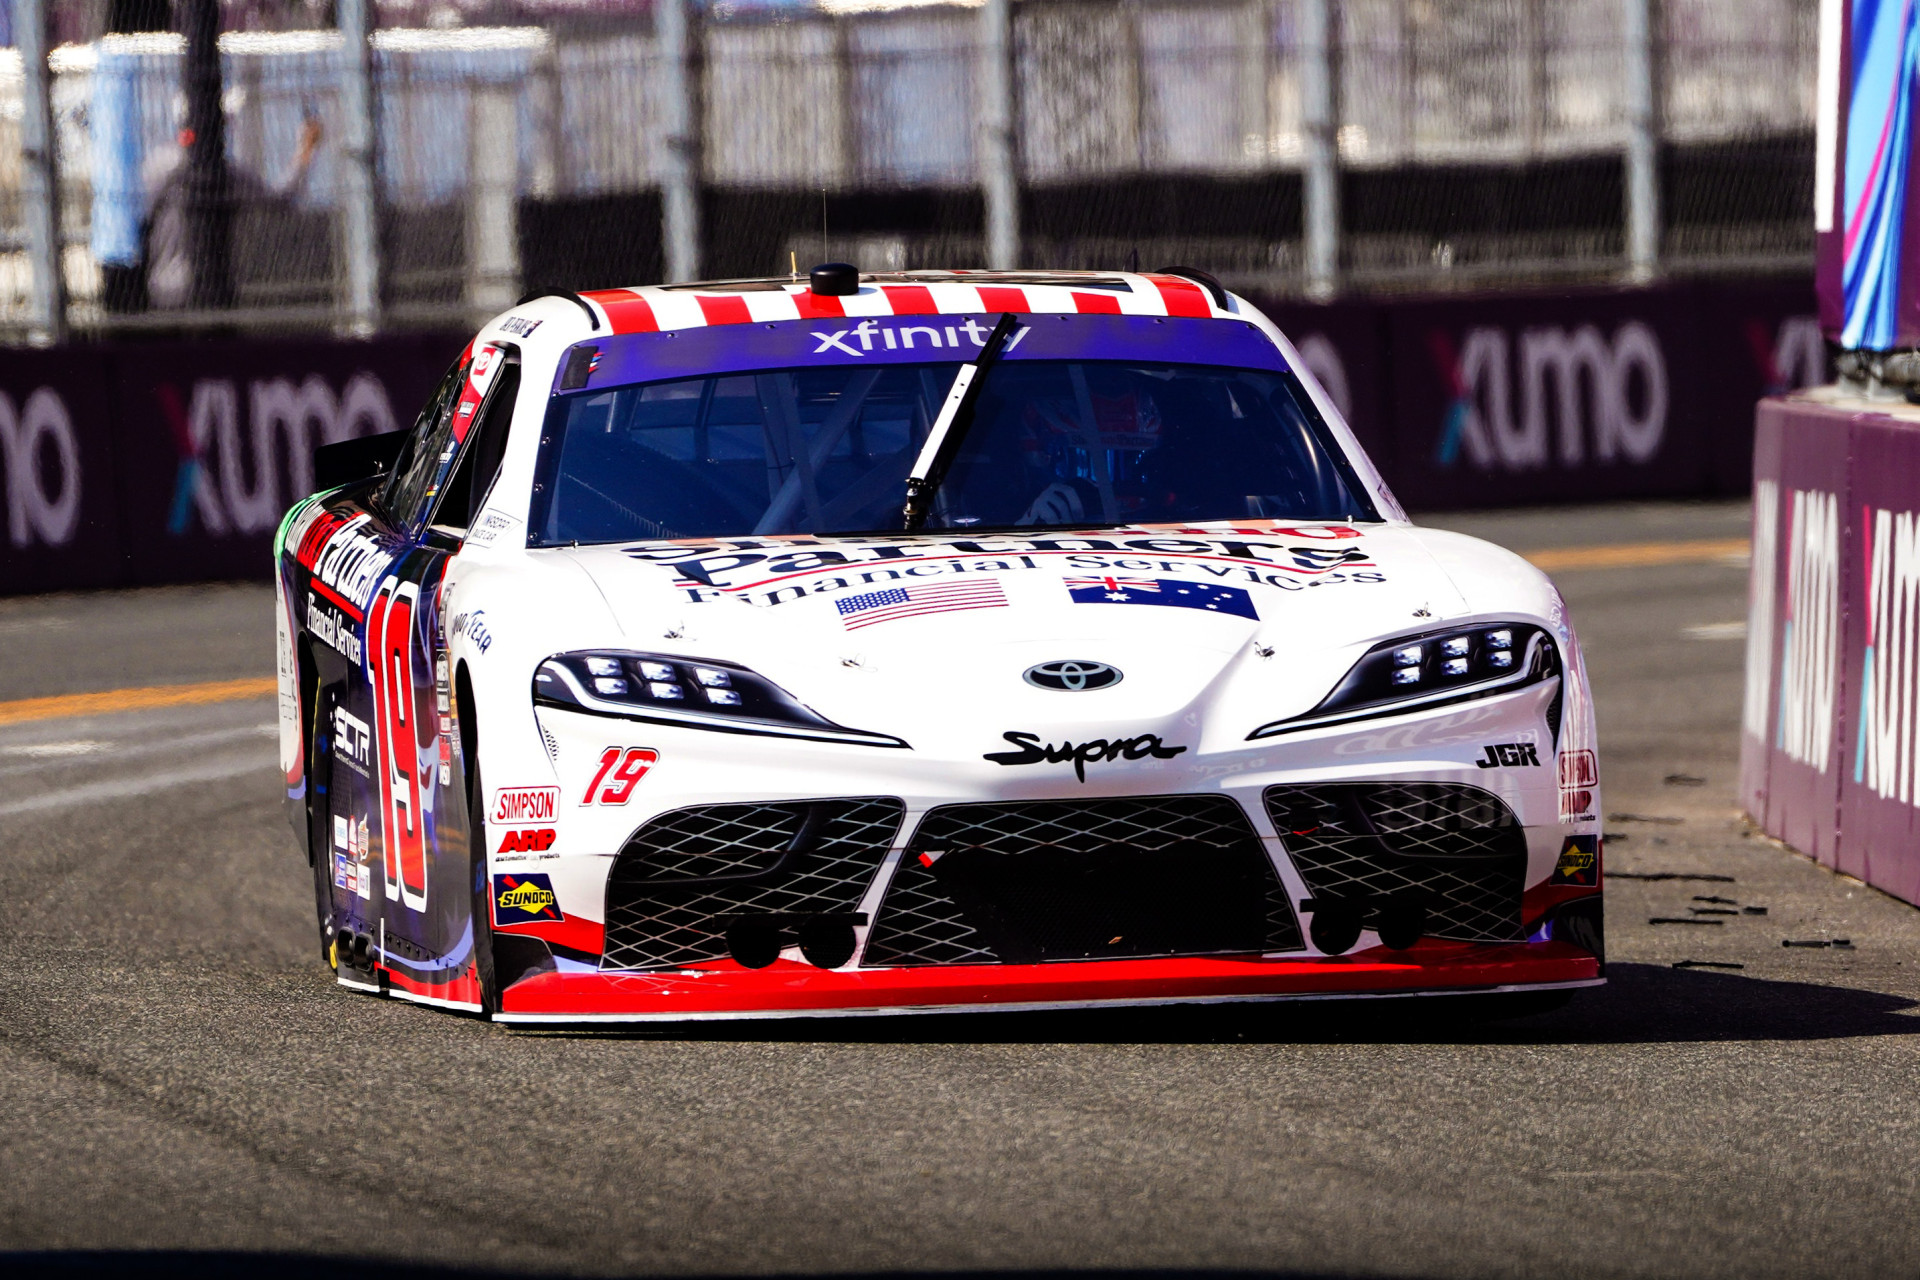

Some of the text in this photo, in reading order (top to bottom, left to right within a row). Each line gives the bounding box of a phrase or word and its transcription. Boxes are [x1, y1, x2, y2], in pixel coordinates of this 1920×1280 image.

[1431, 322, 1668, 466] xumo
[656, 537, 1370, 587] Partners
[677, 555, 1387, 607] Financial Services
[307, 592, 361, 667] Financial Services
[1855, 505, 1920, 807] xum
[335, 705, 370, 766] SCTR
[366, 574, 428, 914] 19
[983, 731, 1188, 783] Supra
[1475, 742, 1541, 769] JGR
[578, 745, 660, 807] 19
[497, 791, 555, 820] SIMPSON
[497, 828, 557, 853] ARP
[502, 891, 553, 906] SUNOCO
